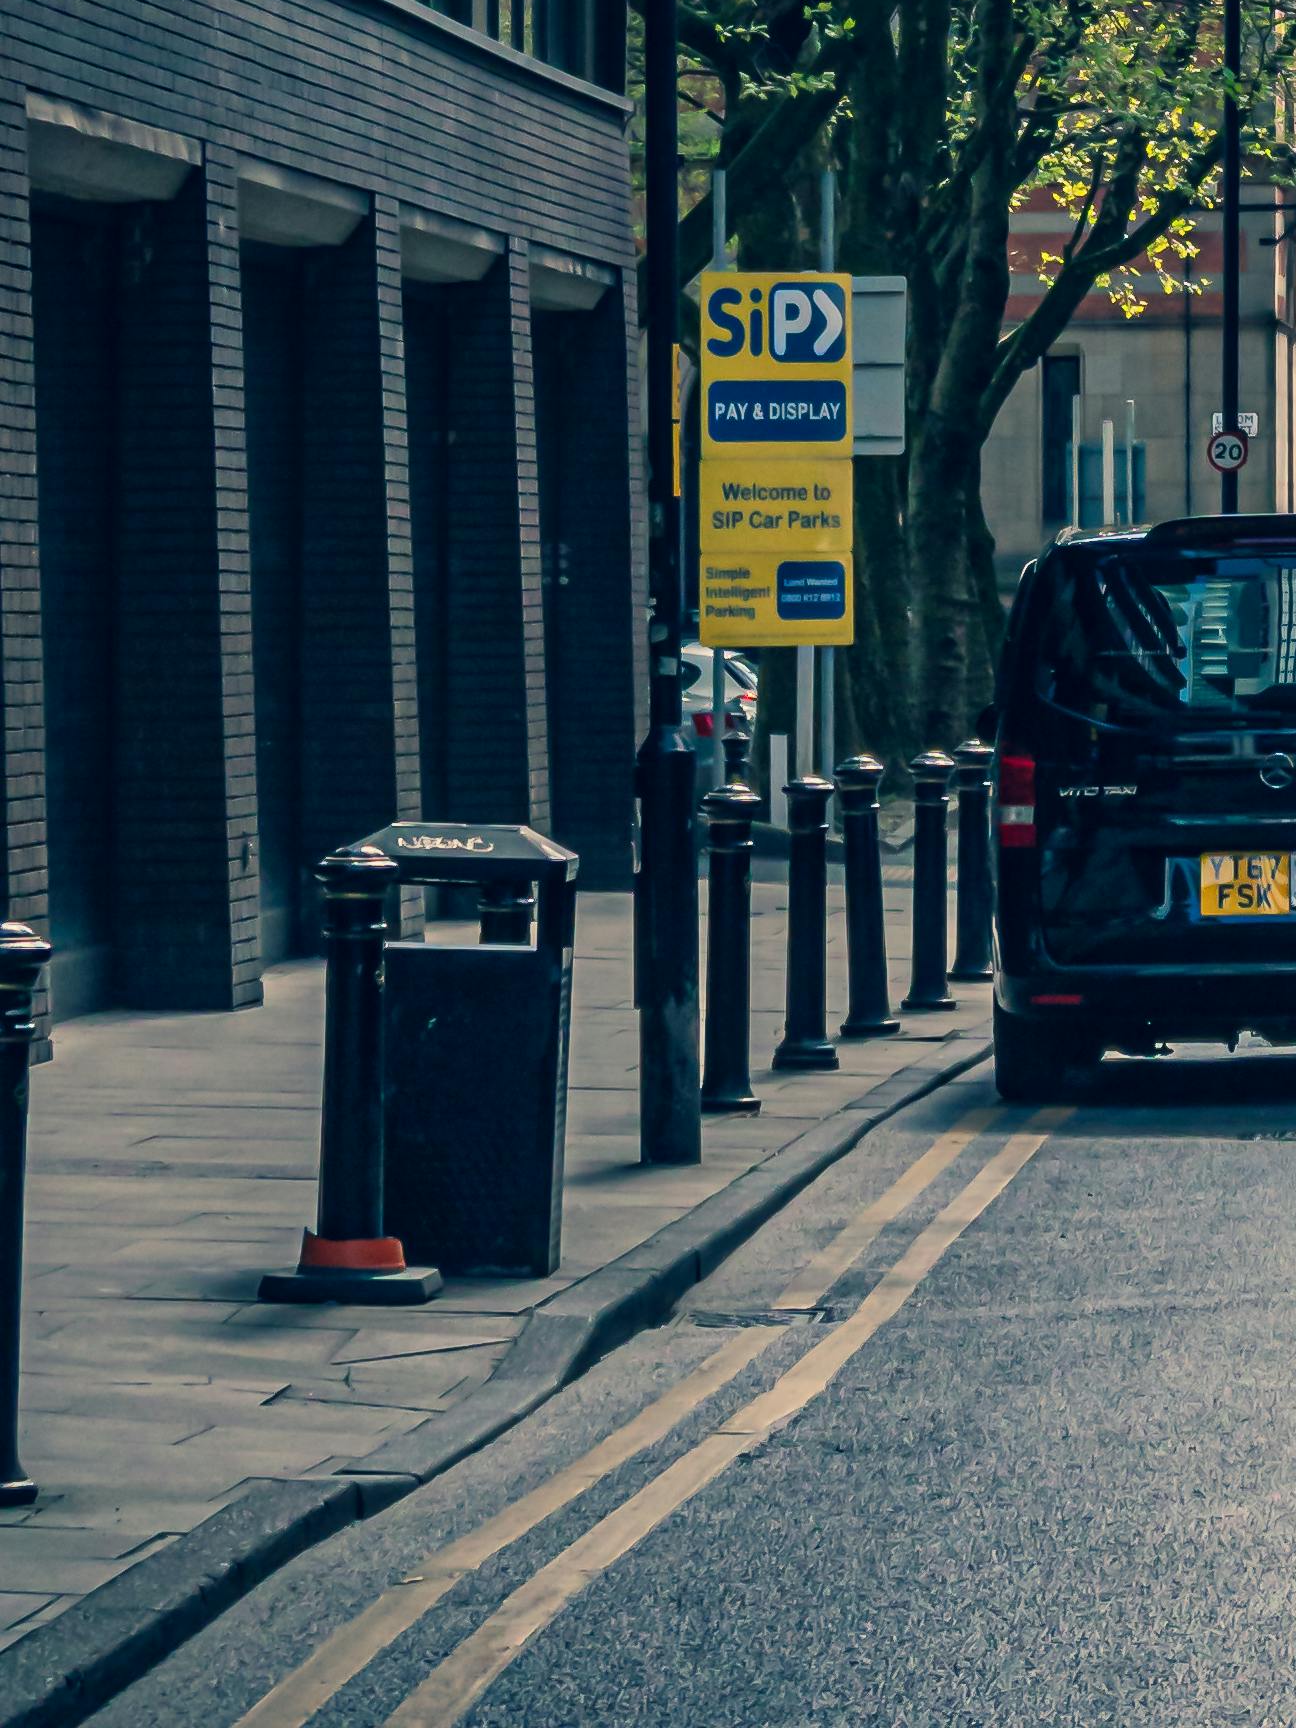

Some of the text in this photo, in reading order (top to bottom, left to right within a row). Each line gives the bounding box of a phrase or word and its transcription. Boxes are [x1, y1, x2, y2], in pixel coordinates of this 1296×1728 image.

[715, 402, 841, 420] PAY & DISPLAY
[1215, 443, 1242, 461] 20
[722, 482, 831, 501] Welcome to
[712, 510, 841, 529] SIP Car Parks
[705, 567, 751, 581] Simple
[705, 586, 771, 601] Intelligent
[705, 605, 756, 620] Parking
